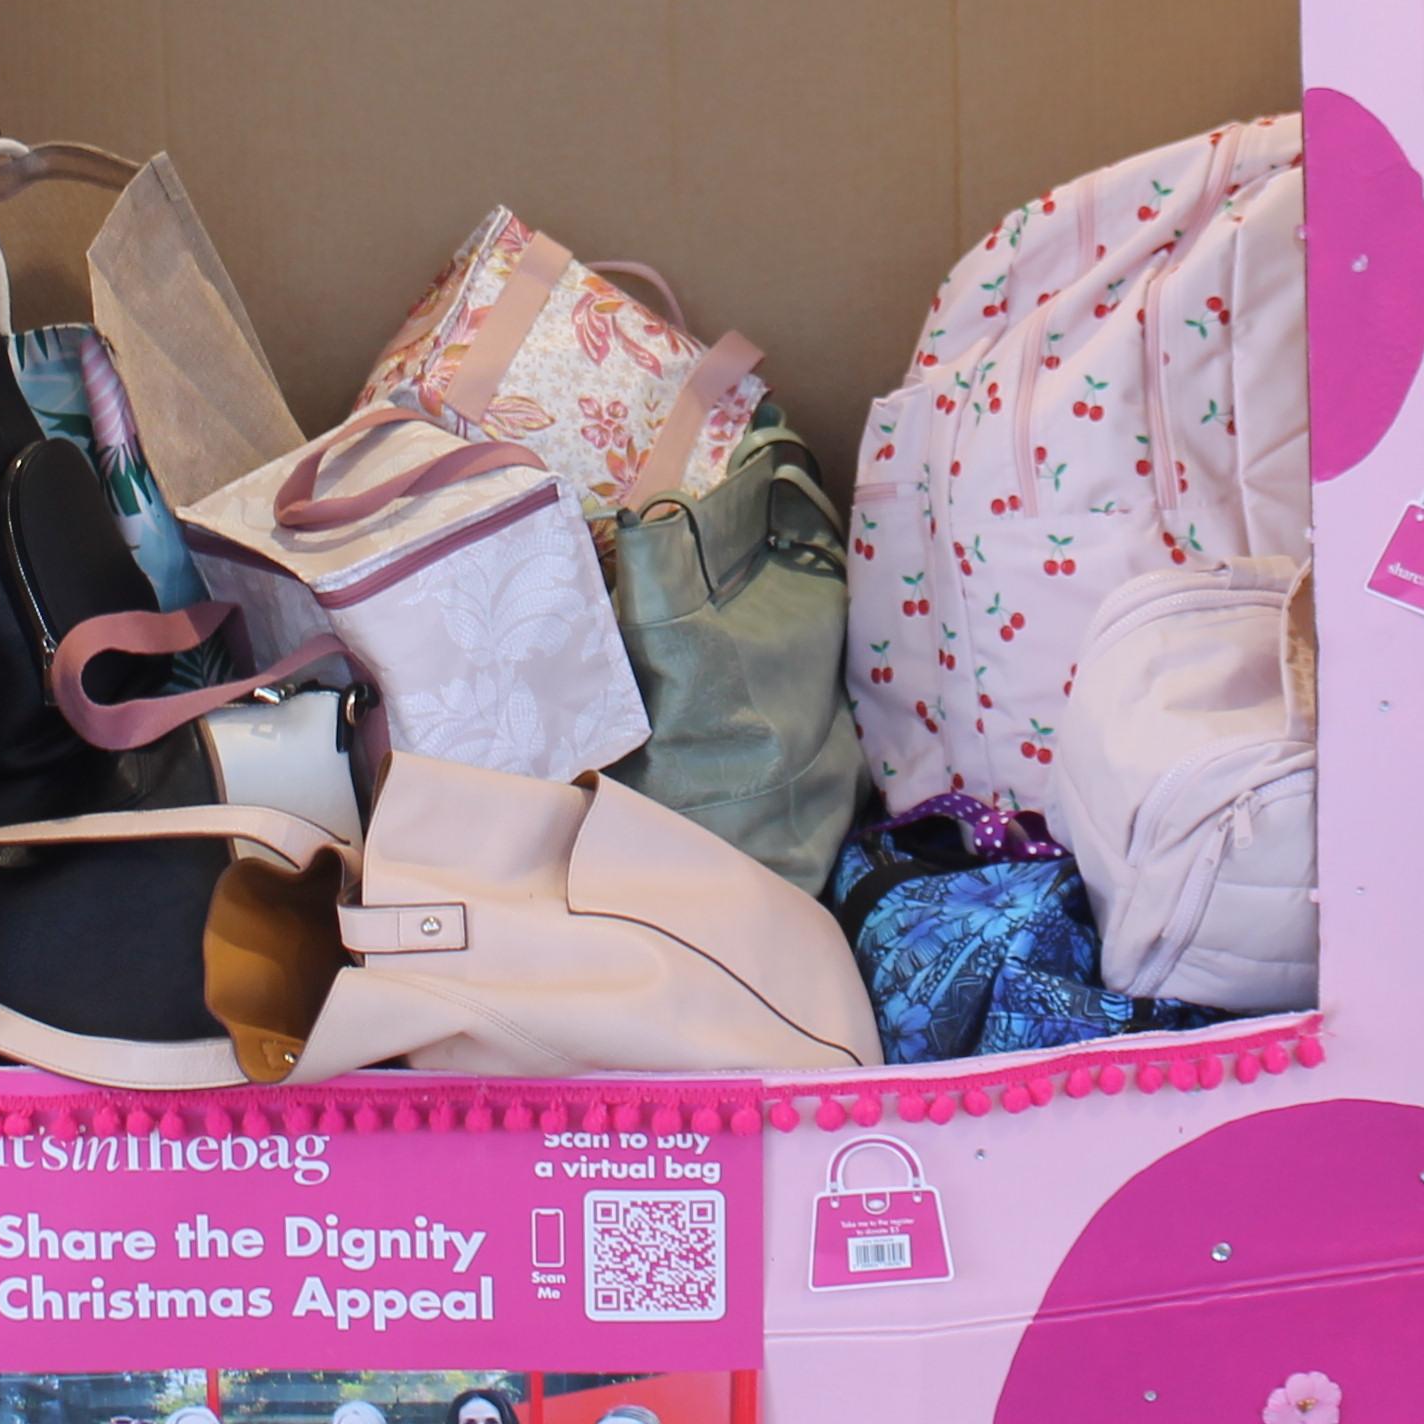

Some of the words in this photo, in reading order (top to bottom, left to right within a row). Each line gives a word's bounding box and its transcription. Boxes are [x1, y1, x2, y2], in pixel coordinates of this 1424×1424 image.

[534, 1161, 554, 1178] a
[562, 1154, 656, 1179] virtual
[664, 1154, 722, 1185] bag
[174, 1213, 266, 1260] the
[284, 1213, 487, 1273] Dignity
[531, 1271, 566, 1285] Scan
[536, 1286, 561, 1300] Me
[291, 1274, 495, 1333] Appeal
